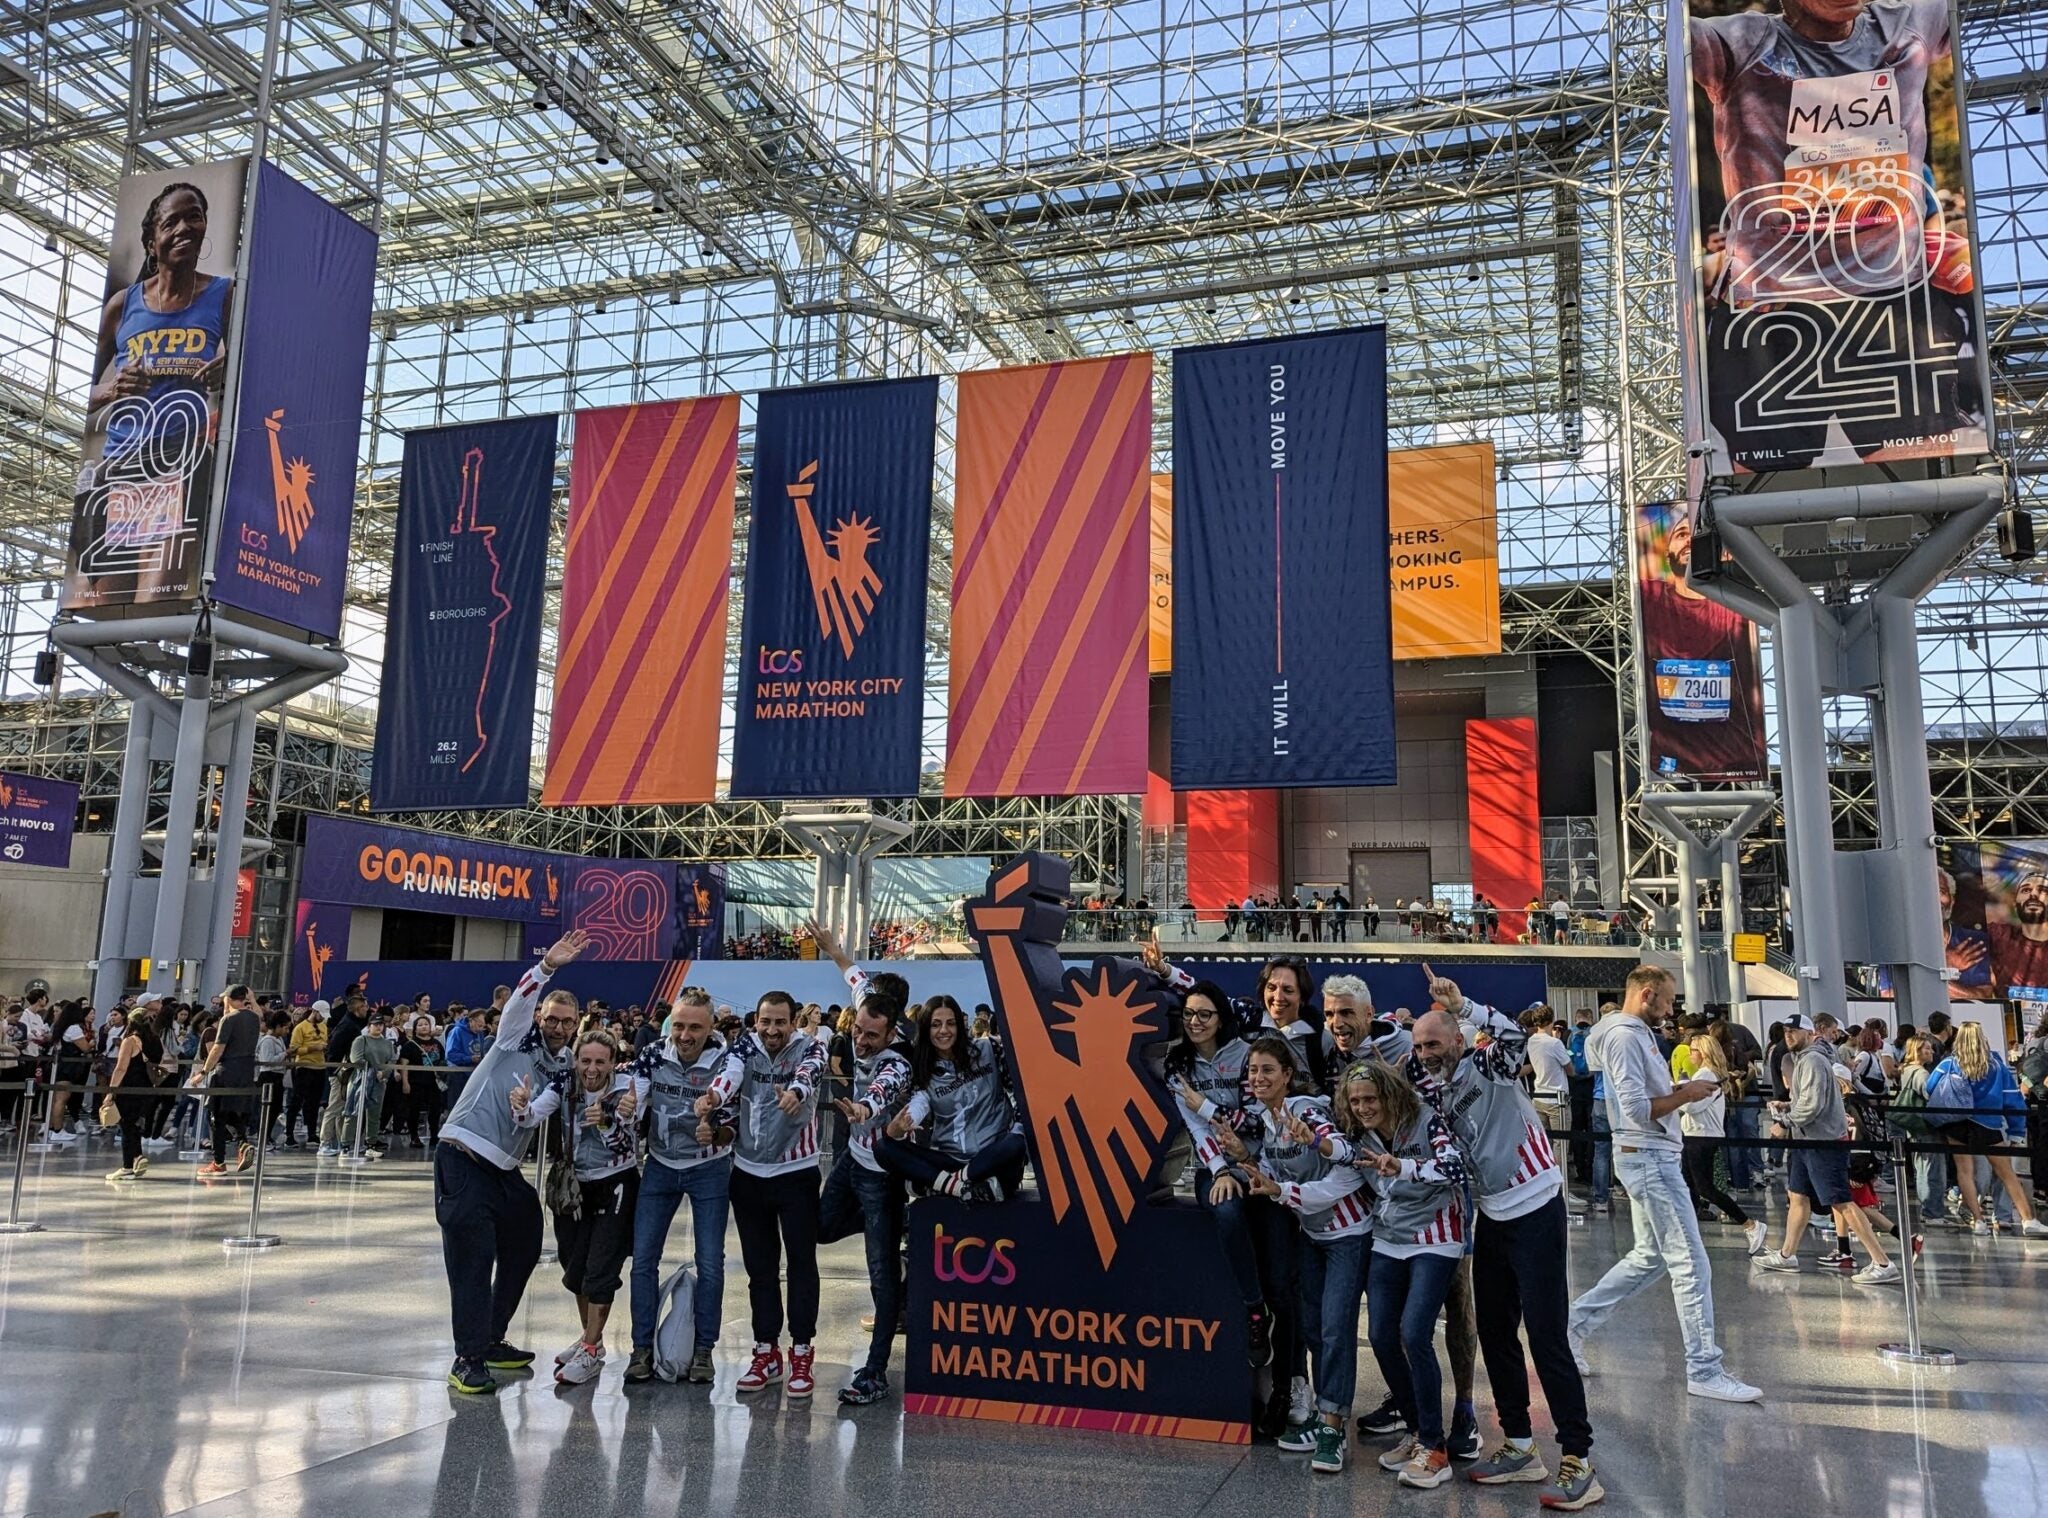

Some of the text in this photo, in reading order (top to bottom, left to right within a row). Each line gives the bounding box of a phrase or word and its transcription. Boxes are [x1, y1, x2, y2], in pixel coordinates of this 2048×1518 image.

[1789, 95, 1894, 133] MASA
[1719, 169, 1946, 314] 20
[127, 328, 206, 361] NYPD
[1724, 298, 1959, 432] 24
[91, 390, 210, 490] 20
[1735, 433, 1959, 461] IT WILL MOVE YOU
[78, 481, 198, 576] 24
[241, 522, 268, 551] tcs
[419, 542, 454, 552] 1 FINISH
[433, 553, 454, 563] LINE
[1271, 363, 1289, 755] IT WILL MOVE YOU
[237, 562, 300, 595] MARATHON
[239, 549, 321, 587] NEW YORK CITY
[83, 590, 100, 599] WILL
[150, 585, 171, 594] MOVE
[174, 583, 189, 592] YOU
[429, 607, 487, 620] 5 BOROUGHS
[759, 644, 803, 674] tcs
[757, 678, 904, 699] NEW YORK CITY
[1685, 679, 1722, 699] 23401
[755, 700, 865, 720] MARATHON
[430, 753, 457, 764] MILES
[437, 741, 458, 751] 26.2
[20, 818, 40, 829] NOV
[41, 821, 55, 831] 03
[1351, 841, 1378, 849] RIVER
[359, 844, 533, 900] GOOD LUCK
[403, 870, 497, 901] RUNNERS!
[232, 879, 245, 928] CENTER
[575, 868, 667, 935] 20
[653, 1081, 681, 1097] FRIENDS
[933, 1223, 1016, 1286] tcs
[931, 1300, 1221, 1352] NEW YORK CITY
[930, 1343, 1146, 1391] MARATHON
